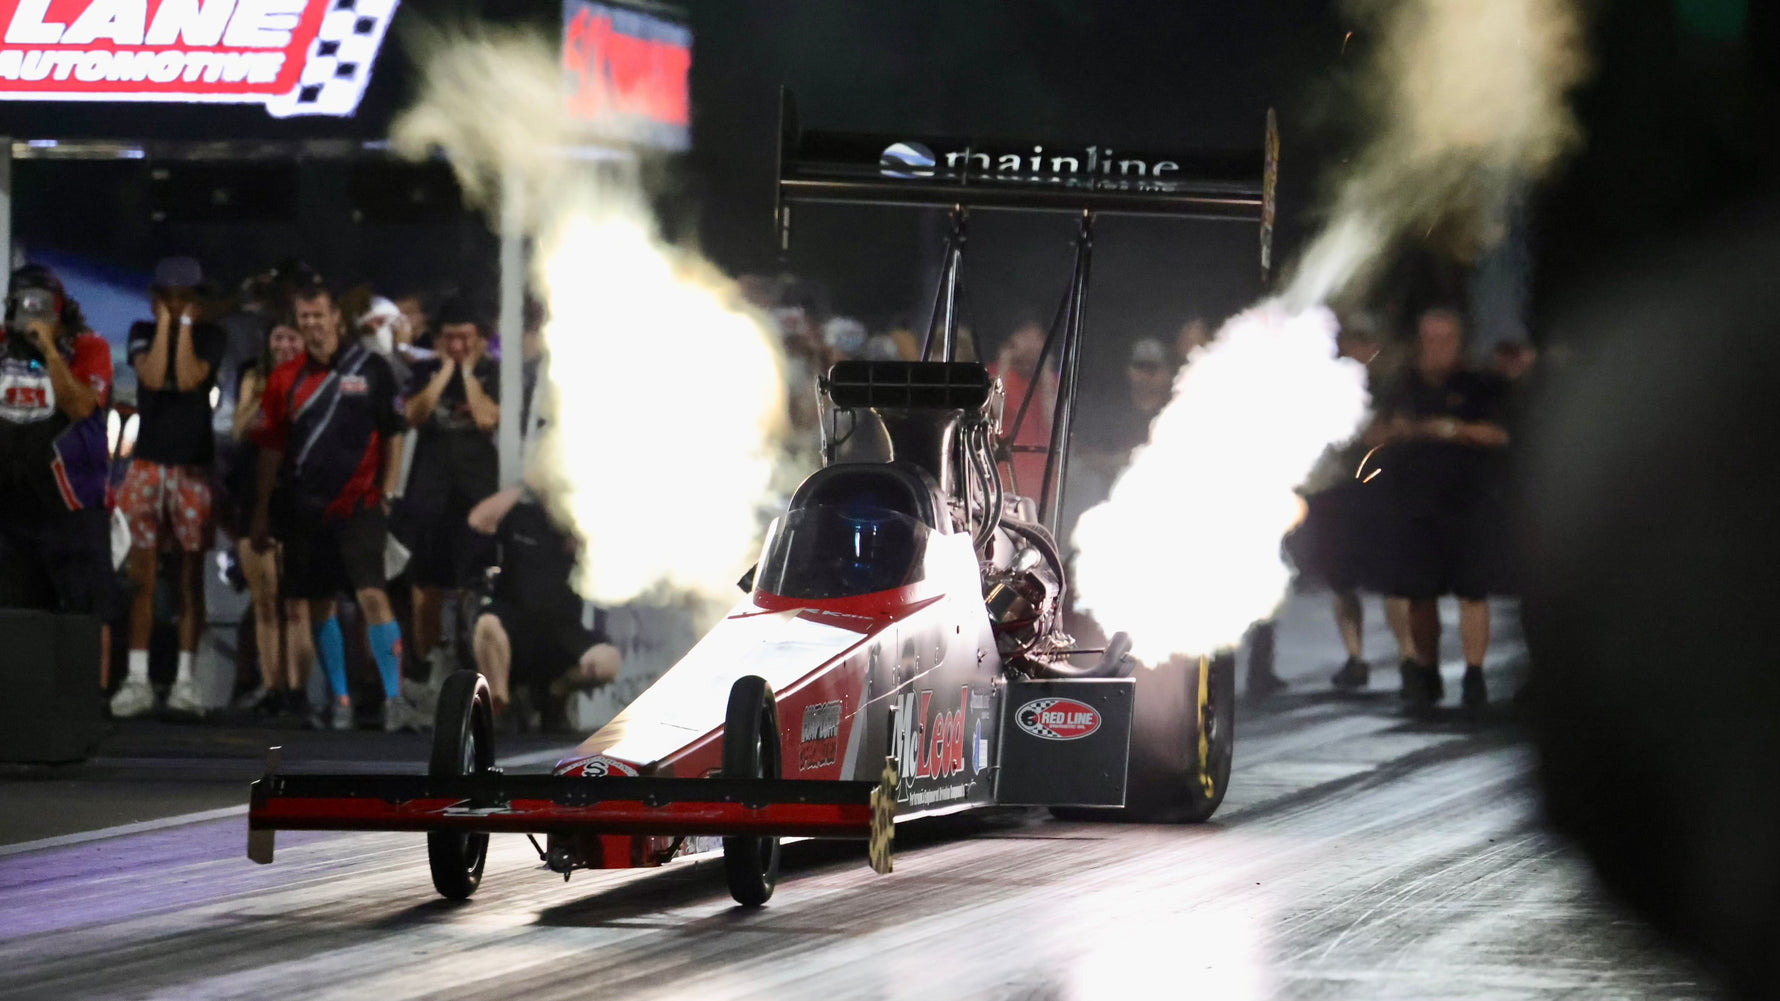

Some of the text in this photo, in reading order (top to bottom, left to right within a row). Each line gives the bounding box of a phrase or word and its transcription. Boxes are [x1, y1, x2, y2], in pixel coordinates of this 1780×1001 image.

[4, 0, 308, 48] LANE
[0, 49, 287, 84] AUTOMOTIVE
[1041, 711, 1093, 725] RED LINE
[886, 684, 969, 801] McLeod
